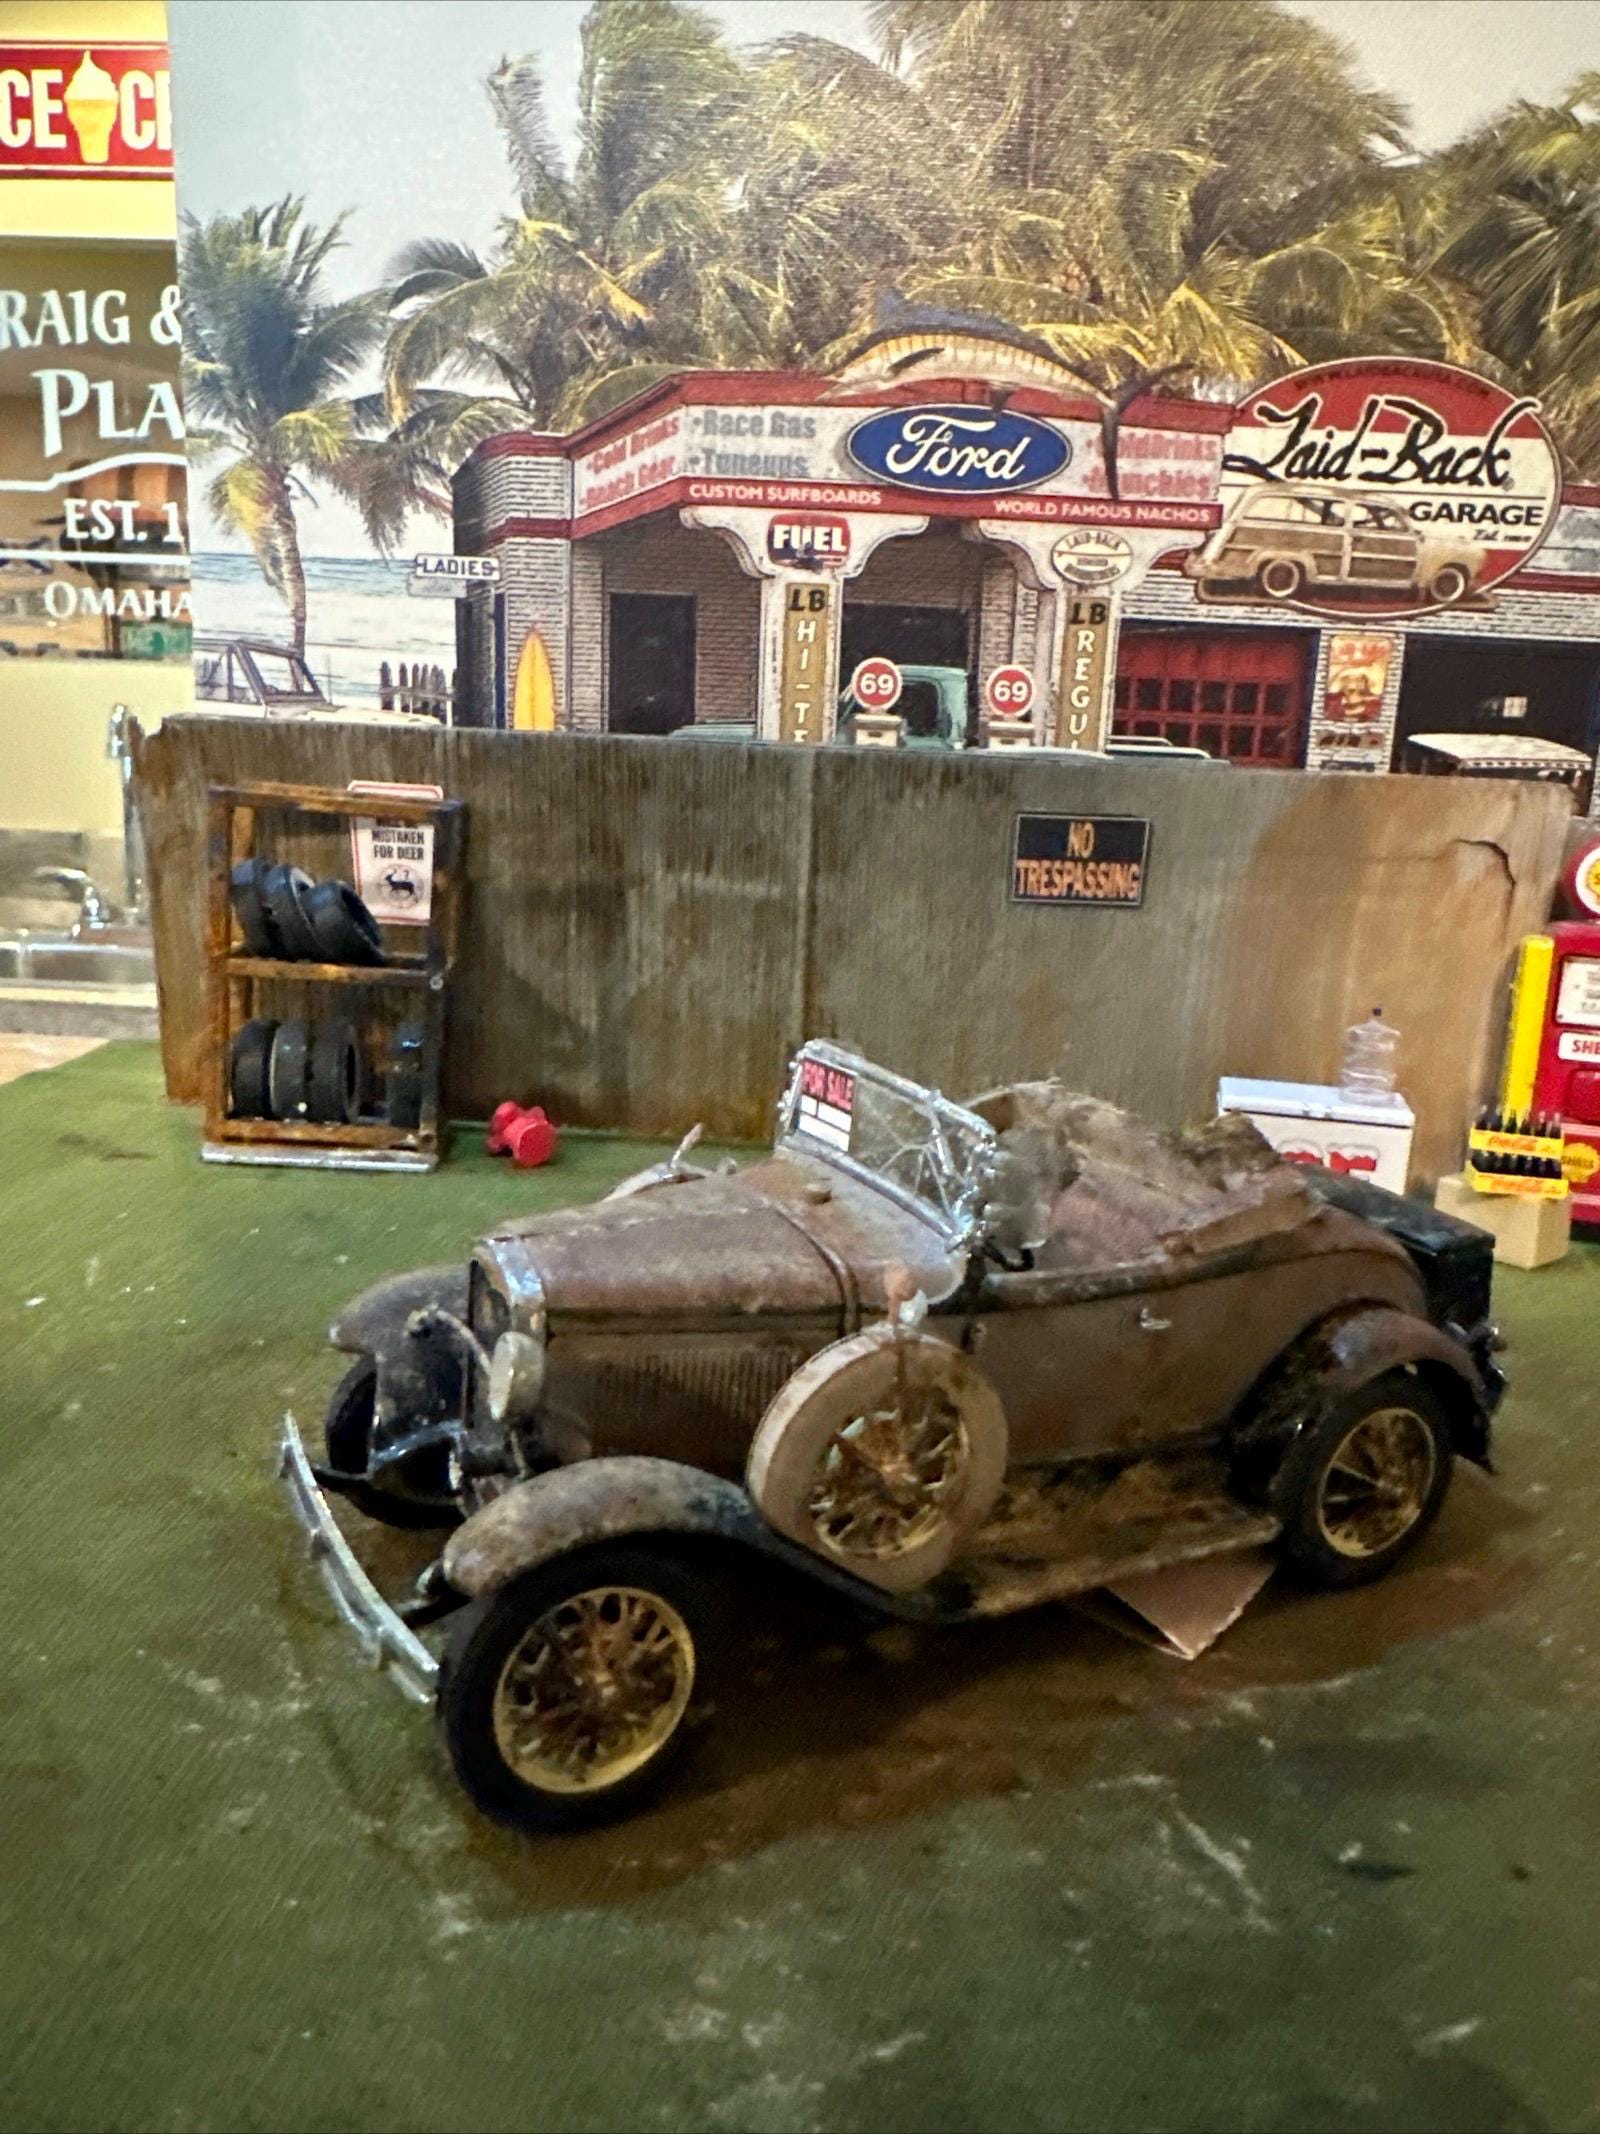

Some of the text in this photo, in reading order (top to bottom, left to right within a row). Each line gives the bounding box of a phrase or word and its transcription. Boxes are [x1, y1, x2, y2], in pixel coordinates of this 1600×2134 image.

[150, 284, 182, 345] &
[32, 369, 186, 458] PLA
[703, 408, 817, 439] Race Gas
[885, 413, 1032, 480] Ford
[689, 483, 881, 506] CUSTOM SURFBOARDS
[64, 498, 147, 542] EST.
[993, 500, 1210, 522] WORLD FAMOUS NACHOS
[1408, 501, 1544, 526] GARAGE
[773, 524, 847, 552] FUEL
[423, 558, 494, 577] LADIES
[789, 588, 826, 613] LB
[1070, 601, 1107, 626] LB
[860, 672, 895, 696] 69
[993, 679, 1028, 703] 69
[371, 828, 425, 845] MISTAKEN
[1067, 821, 1095, 859] NO
[374, 844, 424, 860] FOR DEER
[1016, 859, 1140, 899] TRESPASSING
